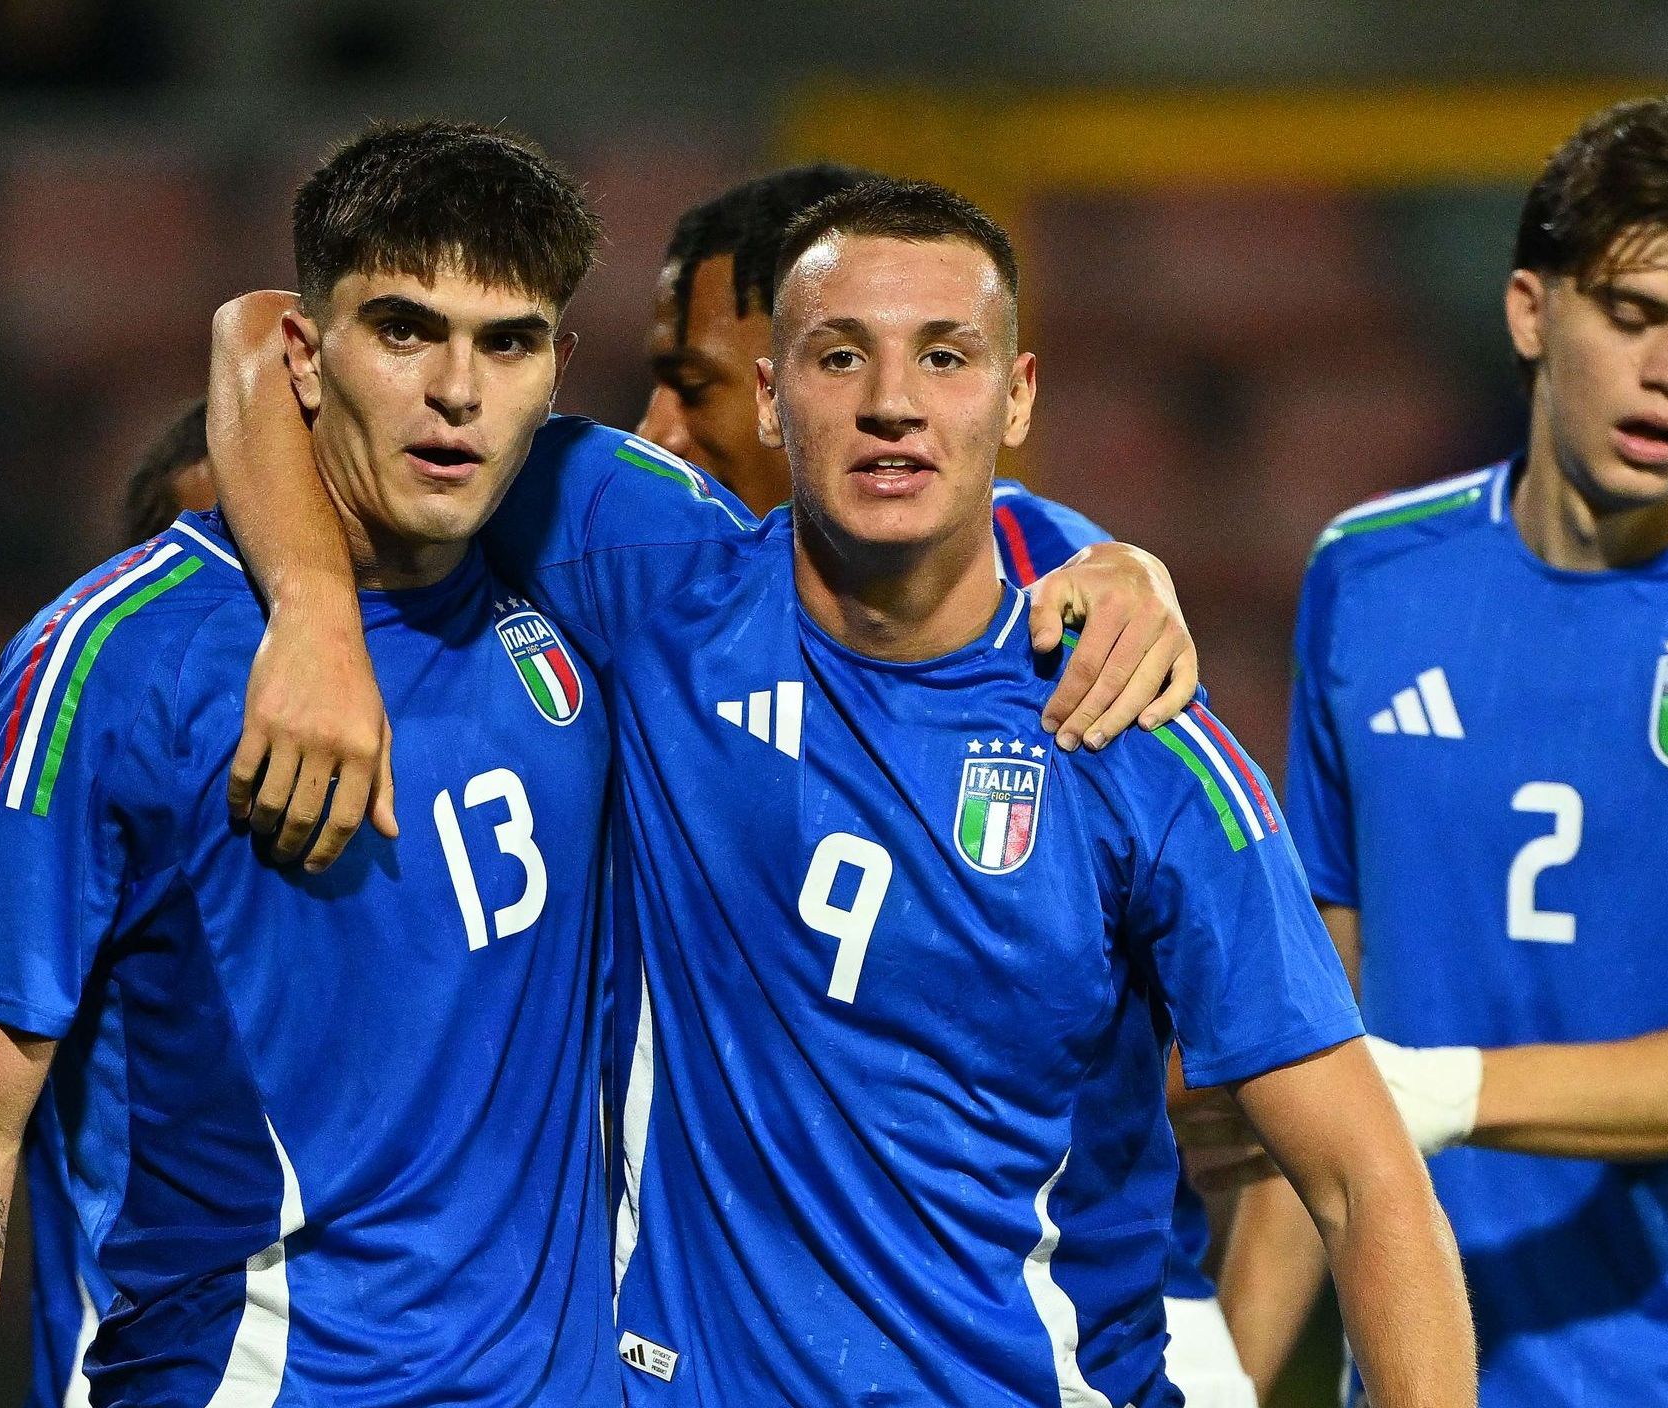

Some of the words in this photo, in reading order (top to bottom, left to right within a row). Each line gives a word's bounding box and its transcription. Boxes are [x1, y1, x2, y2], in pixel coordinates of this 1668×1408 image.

[501, 619, 551, 650] ITALIA
[968, 767, 1035, 793] ITALIA
[991, 791, 1011, 801] FIGC
[433, 768, 548, 952] 13
[1507, 782, 1583, 944] 2
[798, 832, 893, 1004] 9
